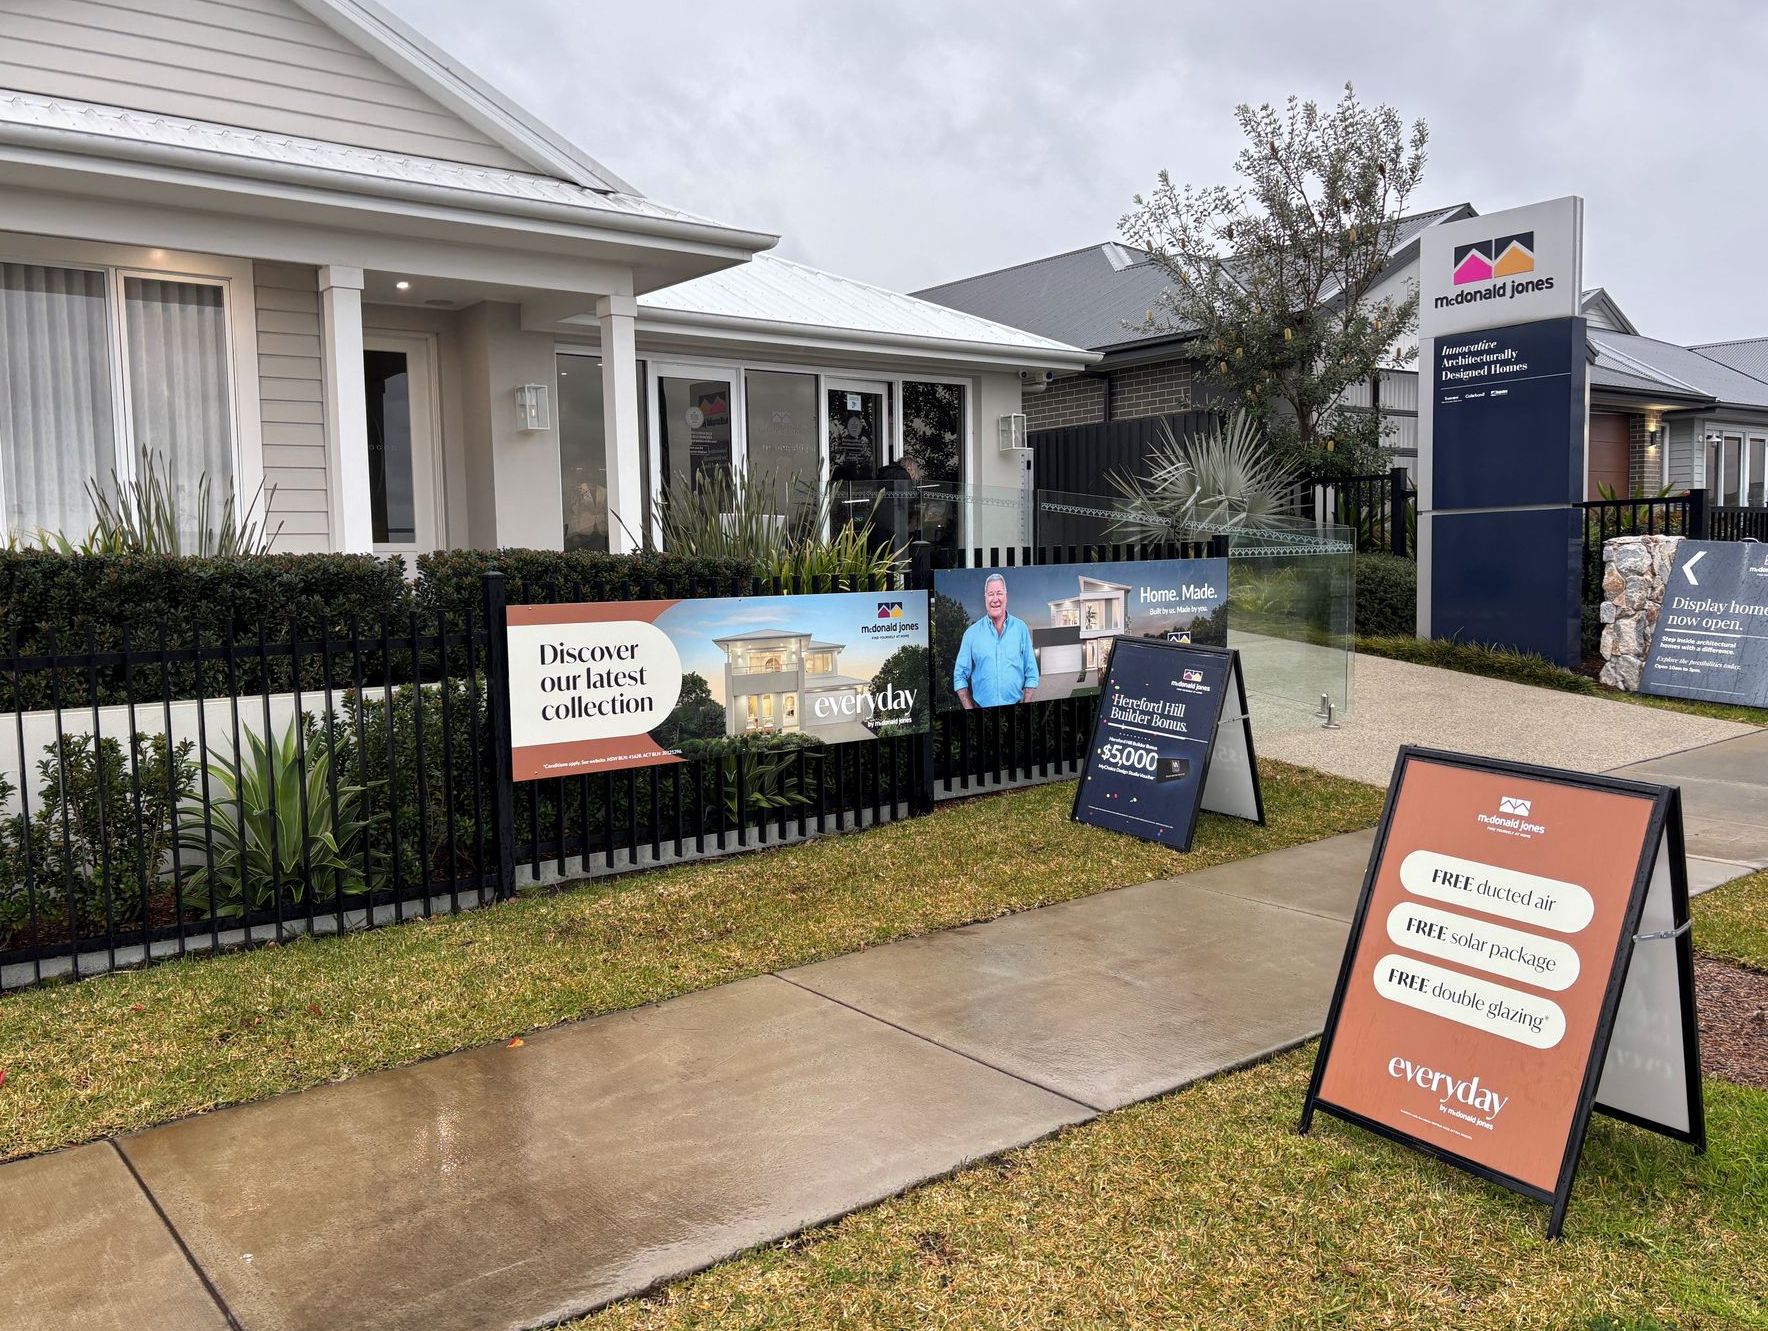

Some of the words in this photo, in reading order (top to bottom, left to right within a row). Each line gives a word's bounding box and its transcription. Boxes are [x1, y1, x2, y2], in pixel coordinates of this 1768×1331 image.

[1434, 281, 1506, 308] mcdonald
[1509, 276, 1554, 299] jones
[1441, 340, 1497, 355] Innovative
[1441, 348, 1518, 368] Architecturally
[1441, 365, 1488, 381] Designed
[1491, 362, 1528, 374] Homes
[1140, 586, 1179, 603] Home.
[1182, 583, 1218, 600] Made.
[1149, 607, 1161, 615] Built
[1161, 607, 1168, 615] by
[1176, 605, 1190, 613] Made
[1190, 605, 1197, 613] by
[1672, 596, 1728, 615] Display
[861, 622, 897, 633] mcdonald
[898, 621, 919, 633] jones
[1667, 615, 1700, 626] now
[1702, 617, 1744, 631] open.
[1659, 642, 1681, 650] homes
[1701, 646, 1735, 655] difference.
[1662, 635, 1677, 643] Step
[1676, 637, 1696, 645] inside
[1696, 639, 1737, 648] architectural
[540, 642, 639, 666] Discover
[540, 674, 582, 693] our
[586, 666, 648, 689] latest
[1195, 683, 1211, 692] jones
[541, 692, 653, 721] collection
[814, 683, 918, 720] everyday
[1113, 693, 1164, 714] Hereford
[1164, 702, 1186, 718] Hill
[897, 717, 912, 726] jones
[1110, 706, 1151, 725] Builder
[1151, 714, 1188, 732] Bonus.
[1101, 743, 1159, 771] $5,000
[1477, 814, 1520, 828] mcdonald
[1518, 820, 1545, 834] jones
[1431, 868, 1475, 892] FREE
[1476, 877, 1533, 906] ducted
[1534, 894, 1557, 912] air
[1405, 917, 1449, 942] FREE
[1449, 931, 1488, 952] solar
[1488, 941, 1557, 974] package
[1388, 968, 1430, 994] FREE
[1431, 982, 1486, 1012] double
[1388, 1056, 1509, 1120] everyday
[1439, 1103, 1448, 1113] by
[1447, 1108, 1477, 1124] mcdonald
[1475, 1117, 1494, 1131] jones
